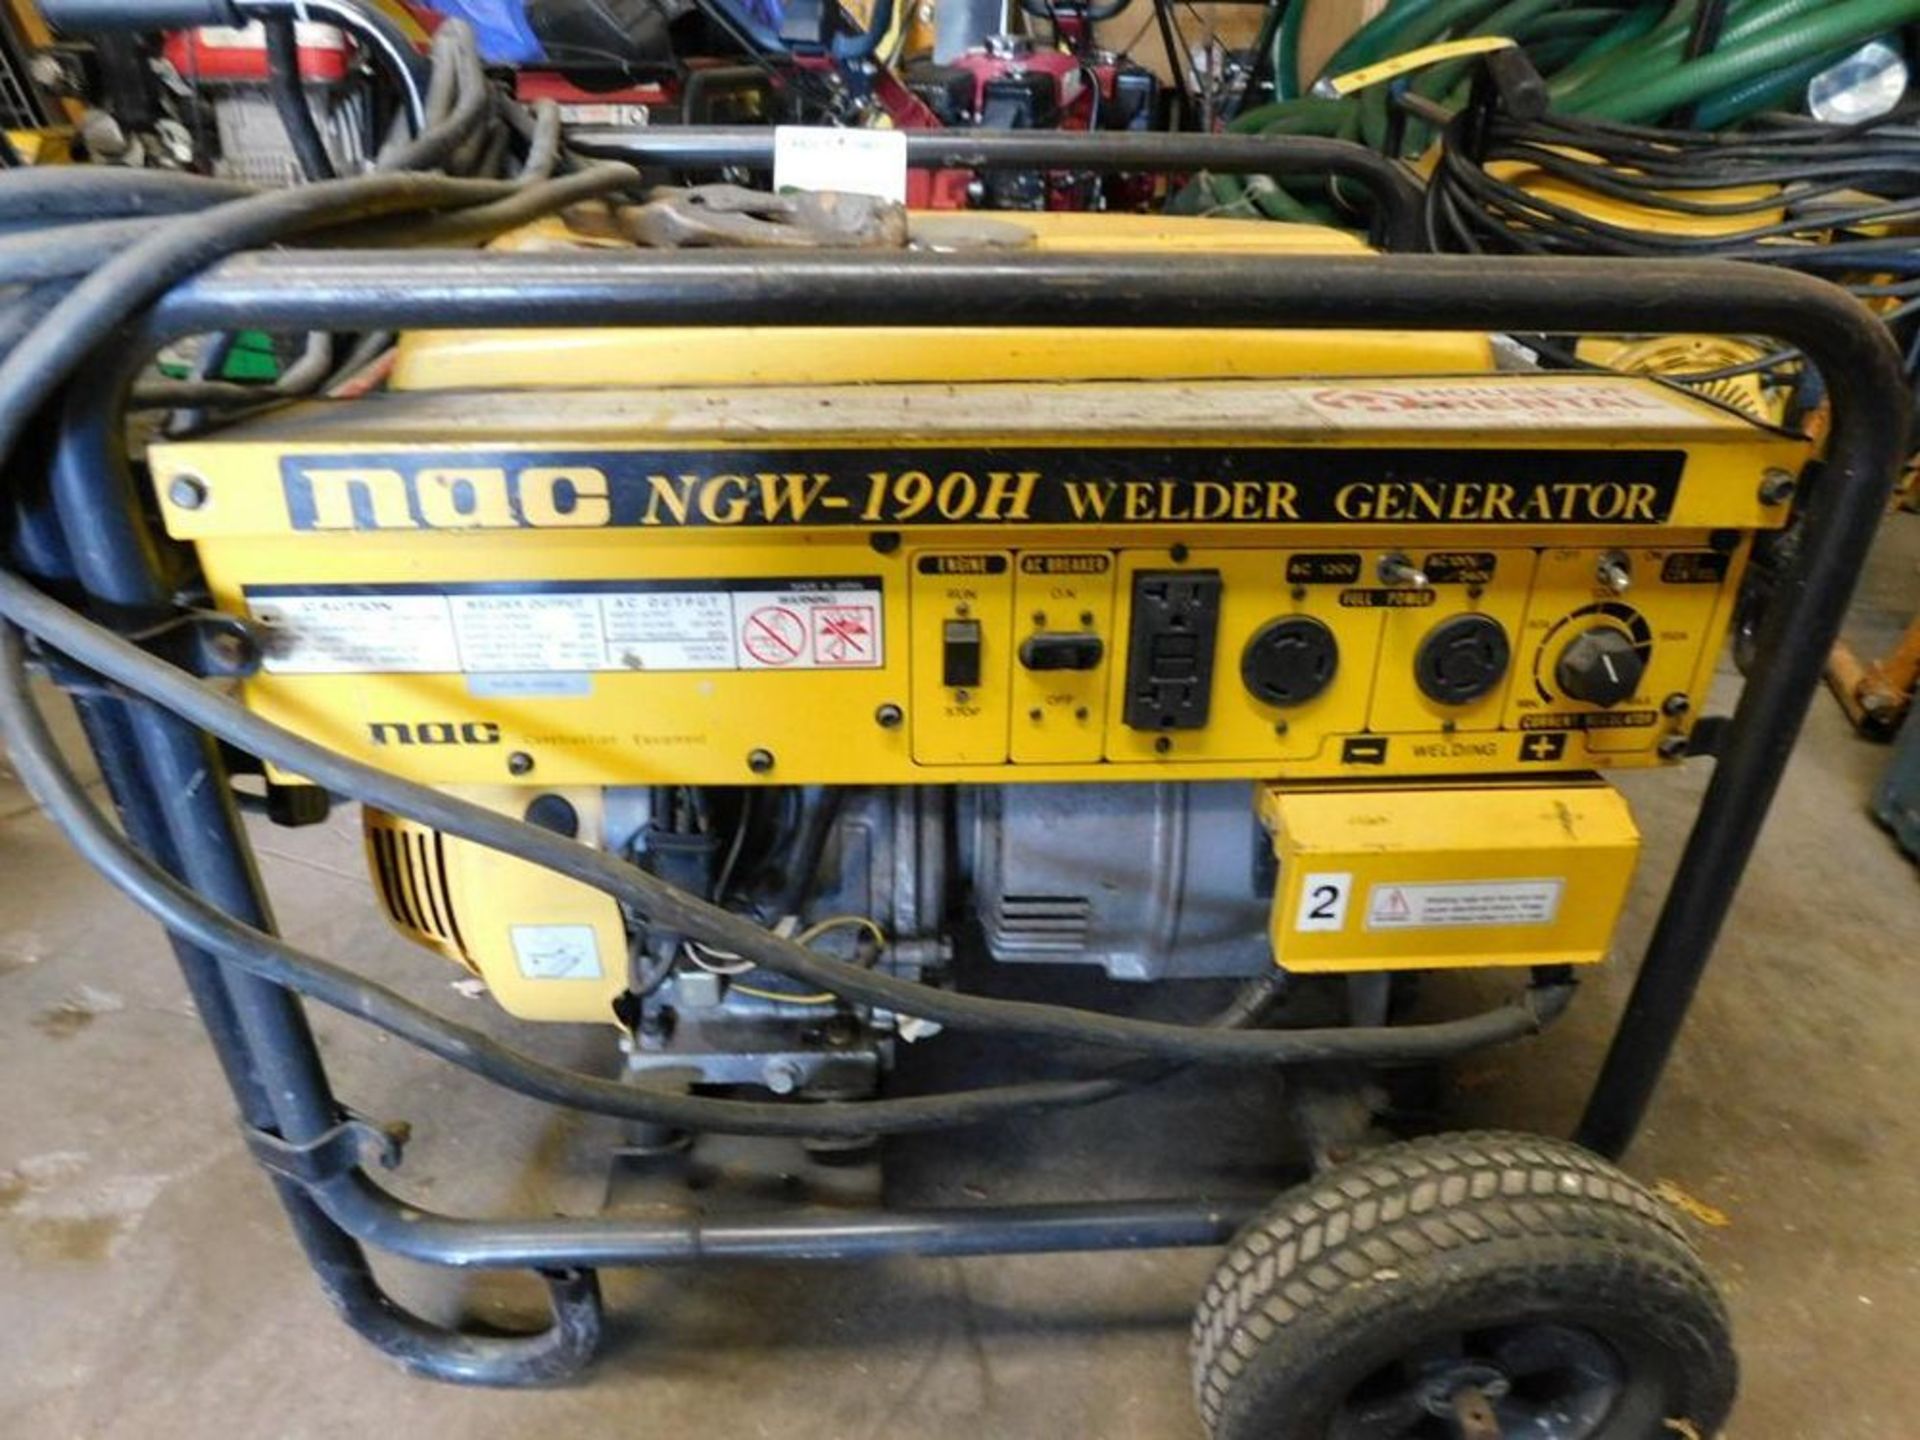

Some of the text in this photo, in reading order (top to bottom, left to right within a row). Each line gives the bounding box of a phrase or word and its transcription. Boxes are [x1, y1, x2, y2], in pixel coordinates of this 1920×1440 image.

[301, 466, 611, 529] nac
[644, 470, 1042, 525] NGW-190H
[1064, 480, 1657, 522] WELDER GENERATOR
[938, 556, 987, 575] ENGINE
[1023, 556, 1106, 574] AC BREAKER
[1342, 591, 1432, 605] FULL POWER
[368, 722, 501, 745] nac
[1411, 742, 1497, 758] WELDING
[1309, 885, 1340, 919] 2
